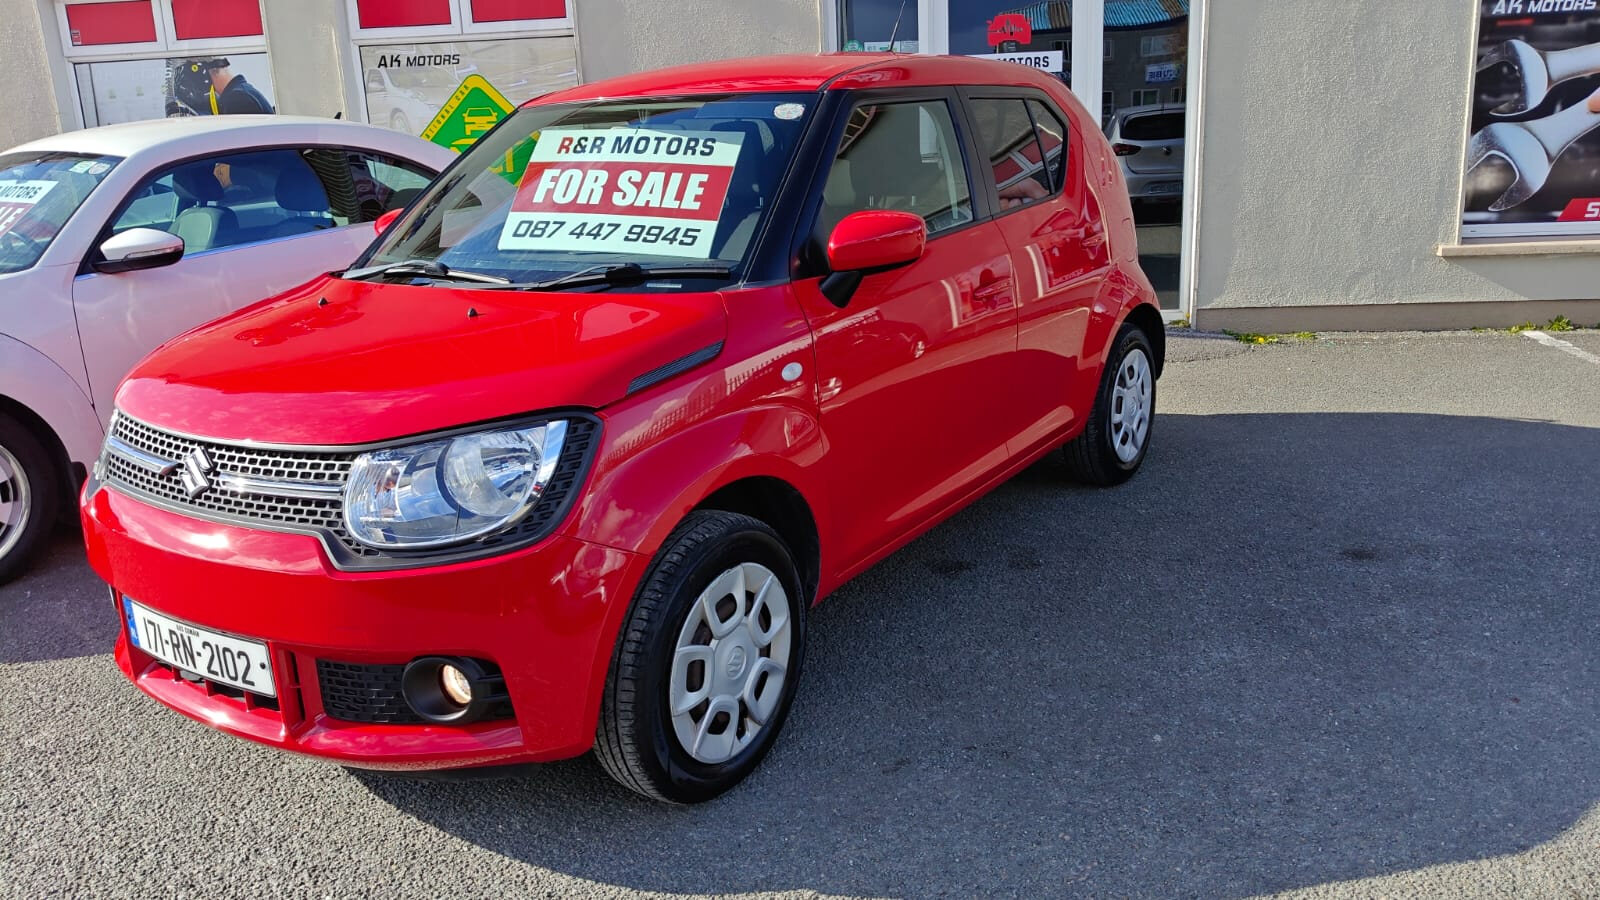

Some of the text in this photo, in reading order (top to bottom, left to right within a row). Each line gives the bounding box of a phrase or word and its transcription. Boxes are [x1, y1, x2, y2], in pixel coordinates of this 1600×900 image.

[1492, 0, 1597, 15] AK MOTORS
[377, 54, 460, 68] AK MOTORS
[424, 104, 454, 139] ATIONAL
[557, 136, 717, 157] R&R MOTORS
[533, 168, 709, 210] FOR SALE
[512, 220, 701, 246] 087 447 9945
[143, 617, 255, 687] 171-RN-2102
